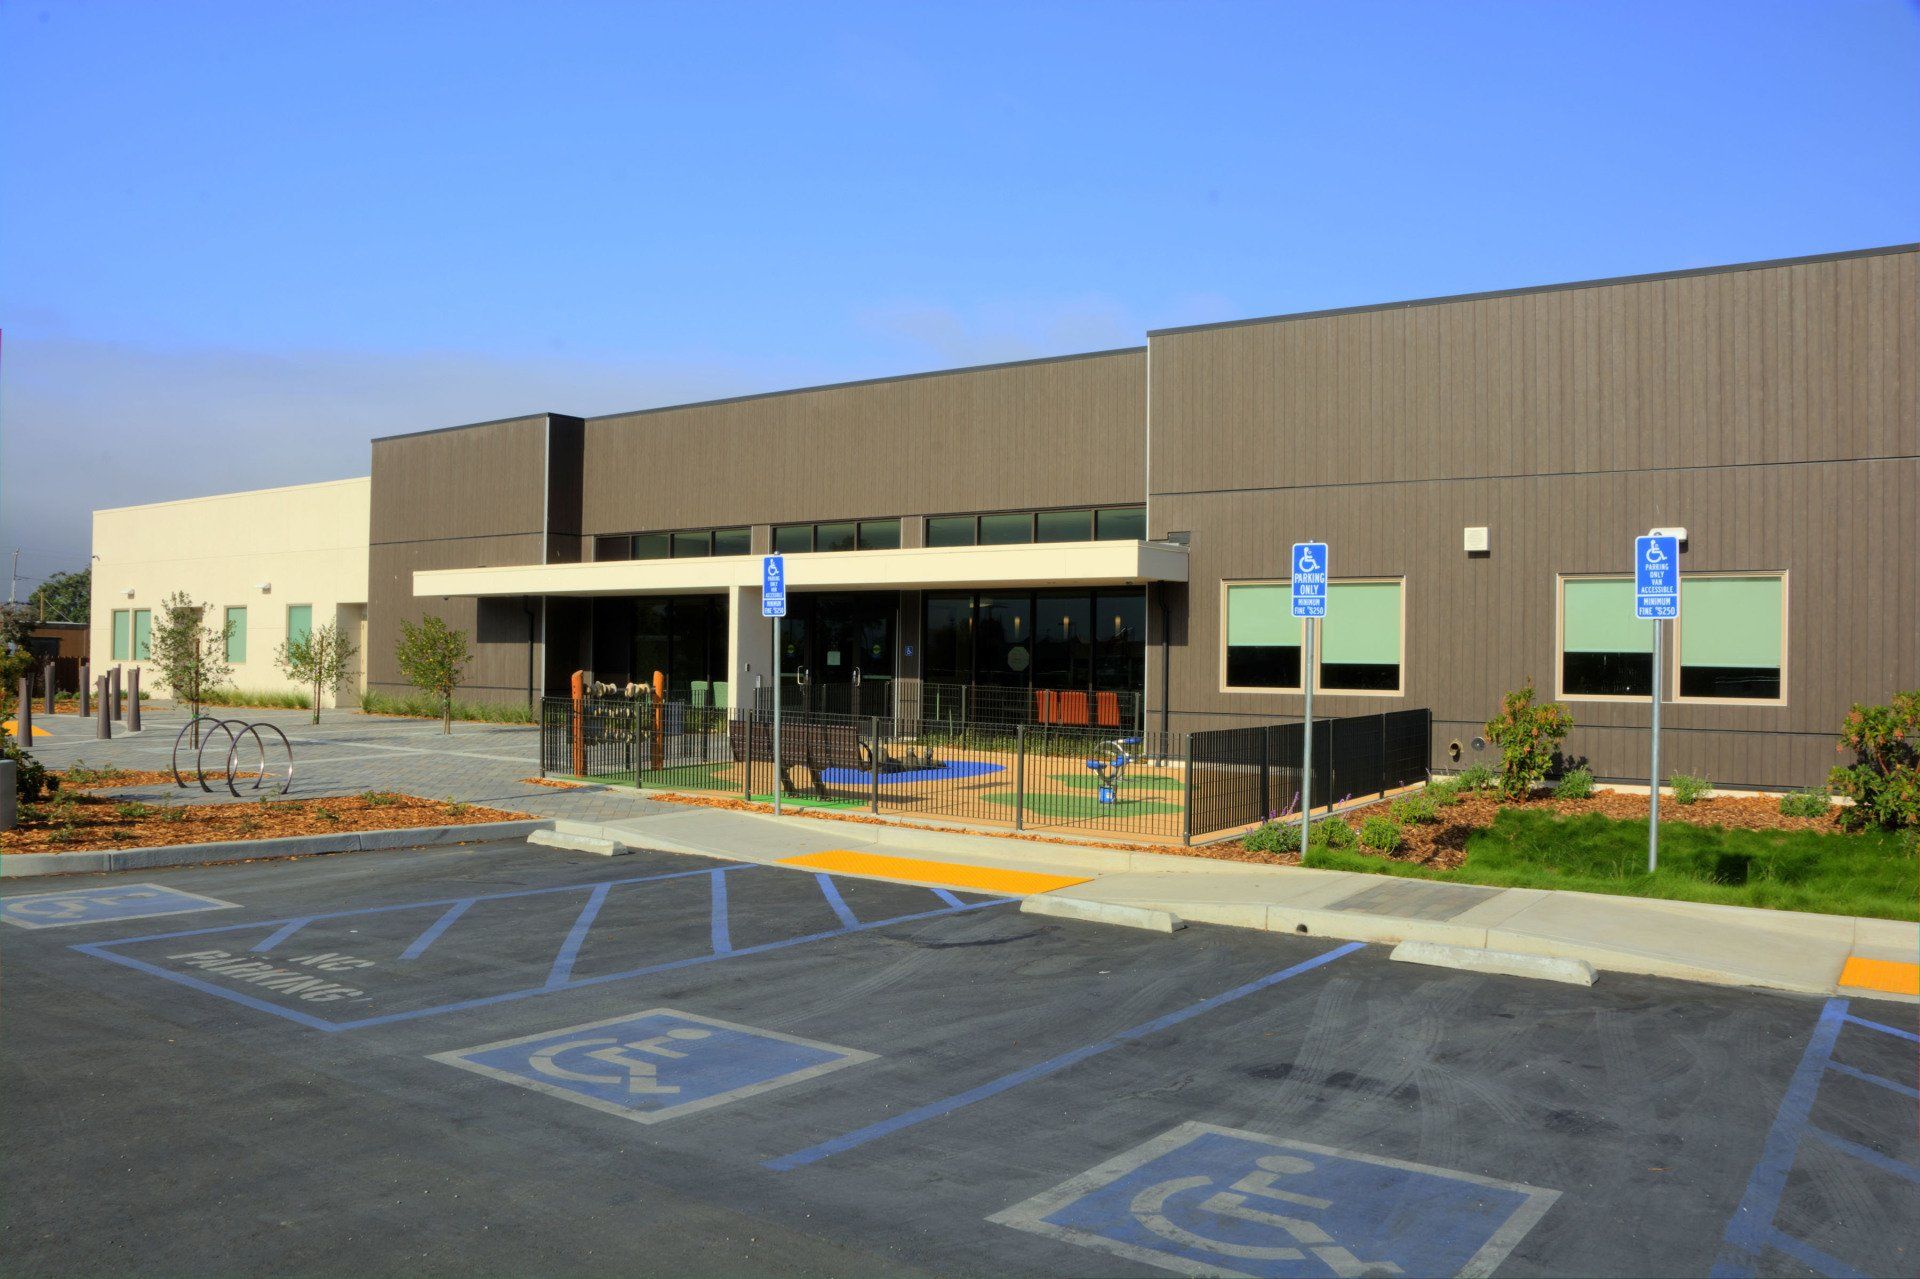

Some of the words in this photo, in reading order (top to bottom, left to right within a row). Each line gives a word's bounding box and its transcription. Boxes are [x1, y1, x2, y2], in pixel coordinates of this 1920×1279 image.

[1645, 563, 1669, 571] PARKING
[1294, 573, 1325, 583] PARKING
[1300, 584, 1319, 595] ONLY
[1643, 597, 1671, 605] MINIMUM
[1639, 607, 1653, 615] FINE
[287, 952, 376, 972] NO
[166, 950, 364, 1002] PARKING
